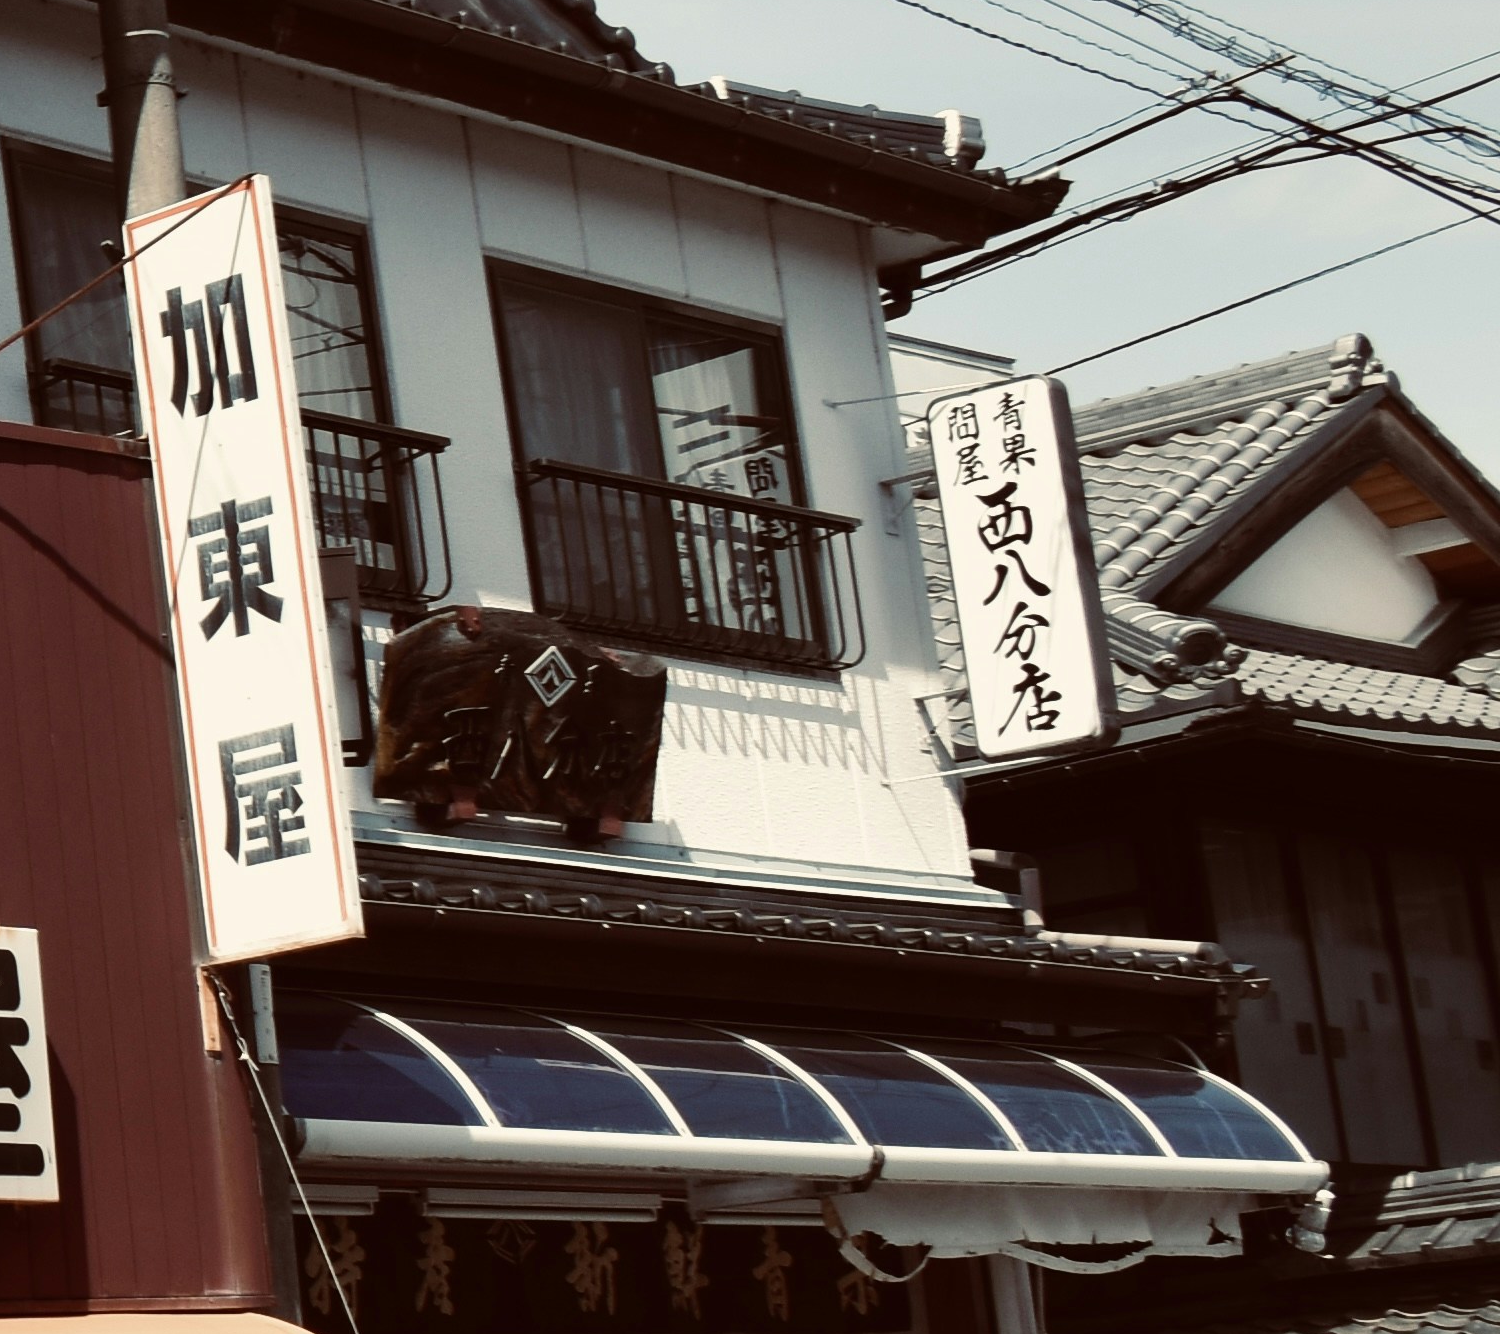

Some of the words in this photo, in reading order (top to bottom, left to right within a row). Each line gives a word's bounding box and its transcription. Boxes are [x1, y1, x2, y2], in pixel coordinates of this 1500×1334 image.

[947, 402, 989, 487] 問屋
[993, 392, 1037, 475] 青果
[159, 275, 310, 867] 加東屋
[974, 481, 1062, 738] 西八分店
